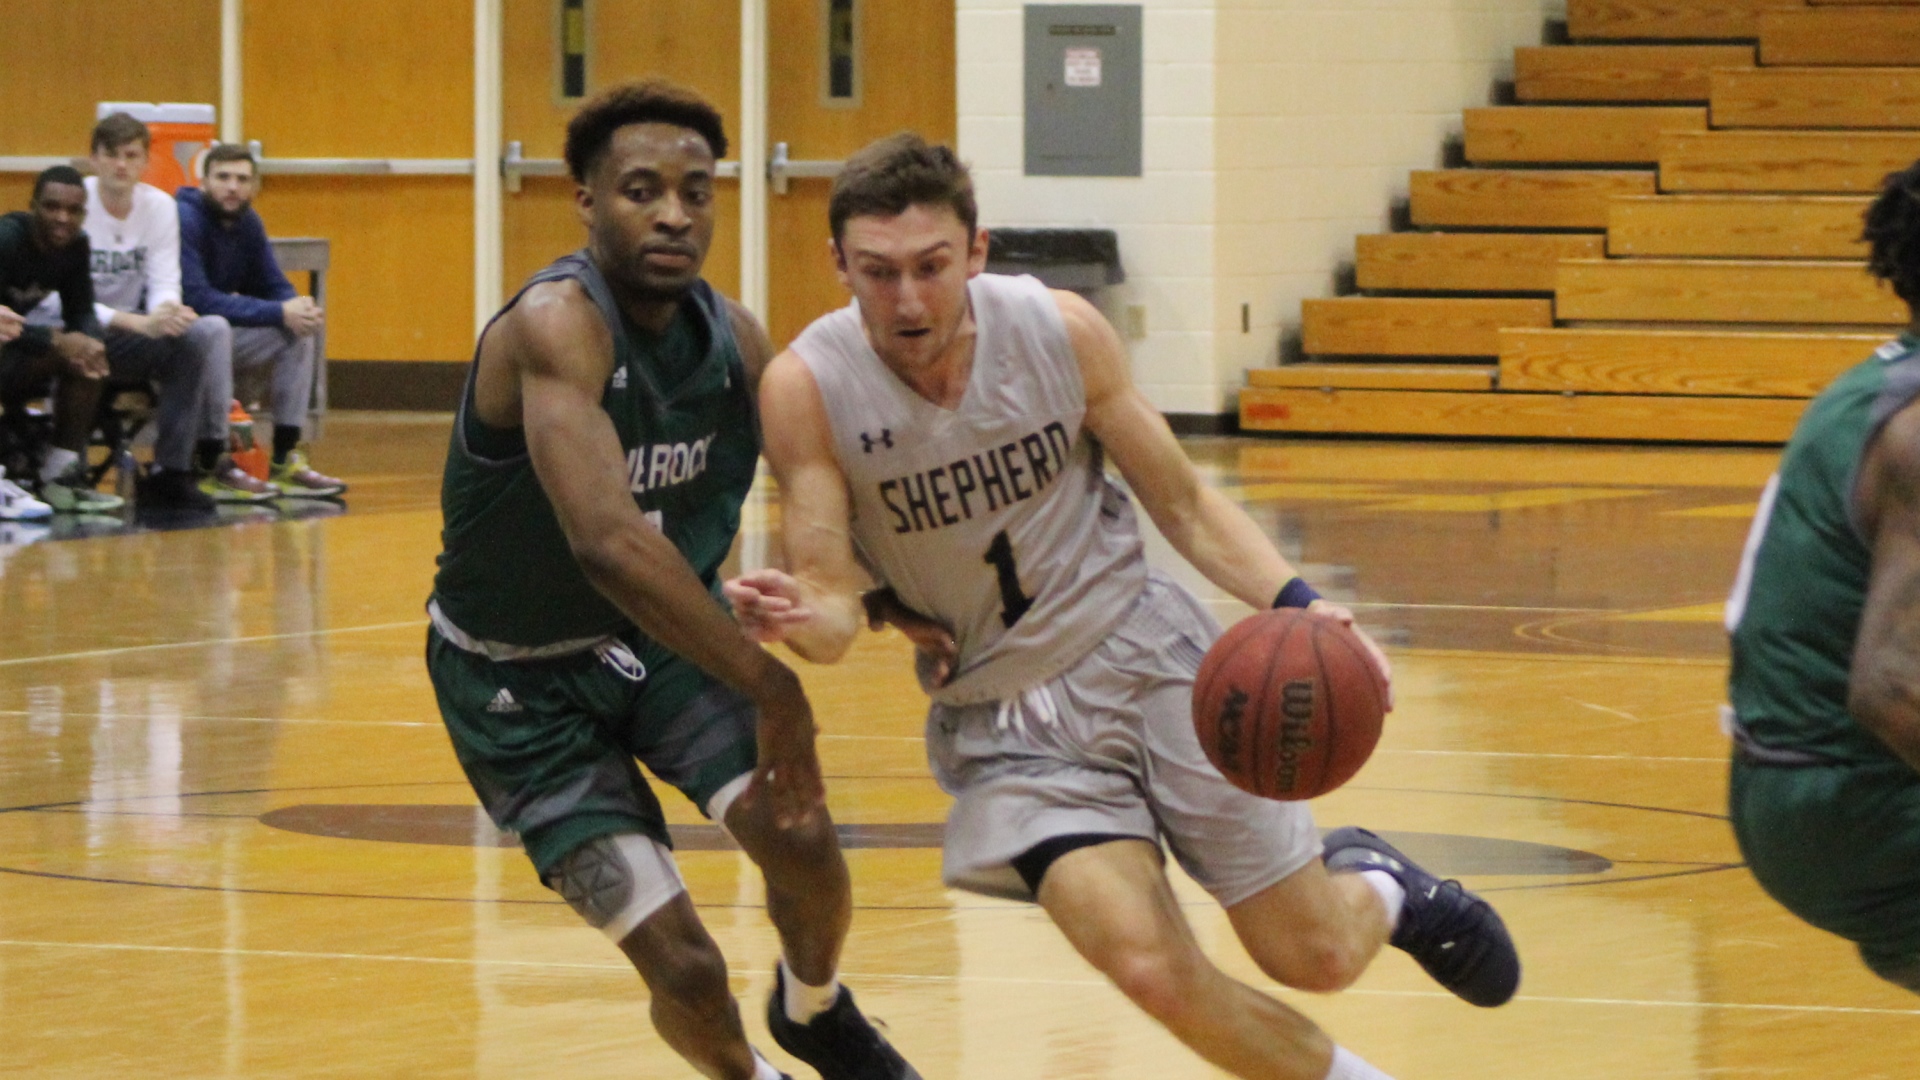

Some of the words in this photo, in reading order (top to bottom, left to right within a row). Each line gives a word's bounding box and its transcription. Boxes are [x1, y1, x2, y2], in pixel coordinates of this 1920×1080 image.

[880, 421, 1070, 533] SHEPHERD
[984, 529, 1036, 628] 1
[1276, 680, 1316, 792] Wilson
